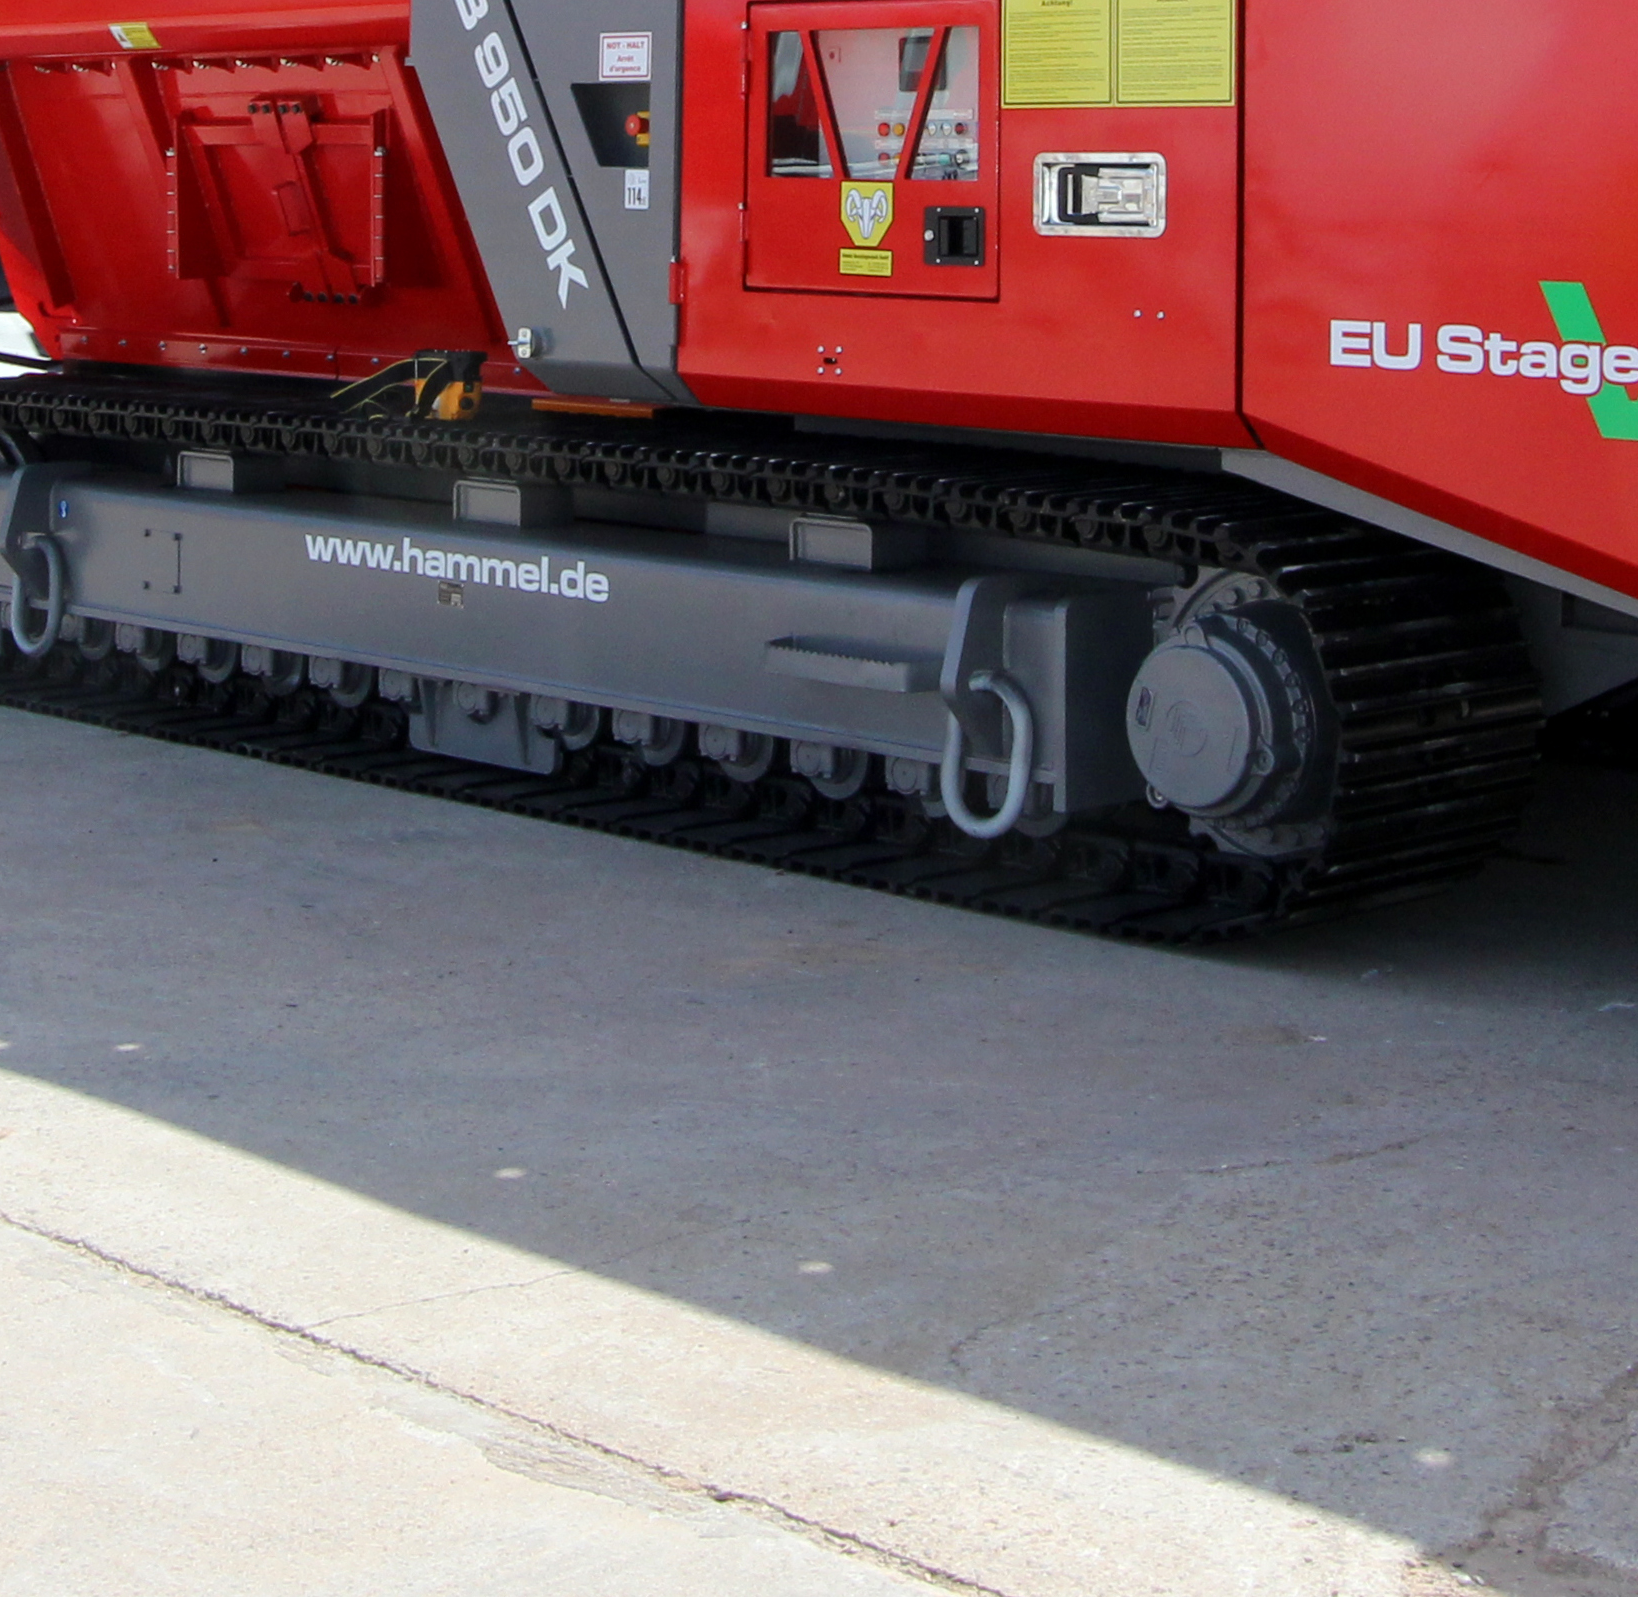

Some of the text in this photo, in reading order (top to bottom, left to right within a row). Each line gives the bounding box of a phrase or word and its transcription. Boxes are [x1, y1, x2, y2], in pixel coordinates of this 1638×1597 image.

[474, 31, 544, 186] 950
[527, 186, 589, 310] DK
[627, 187, 642, 206] 114
[1330, 319, 1423, 371] EU
[304, 533, 610, 603] www.hammel.de
